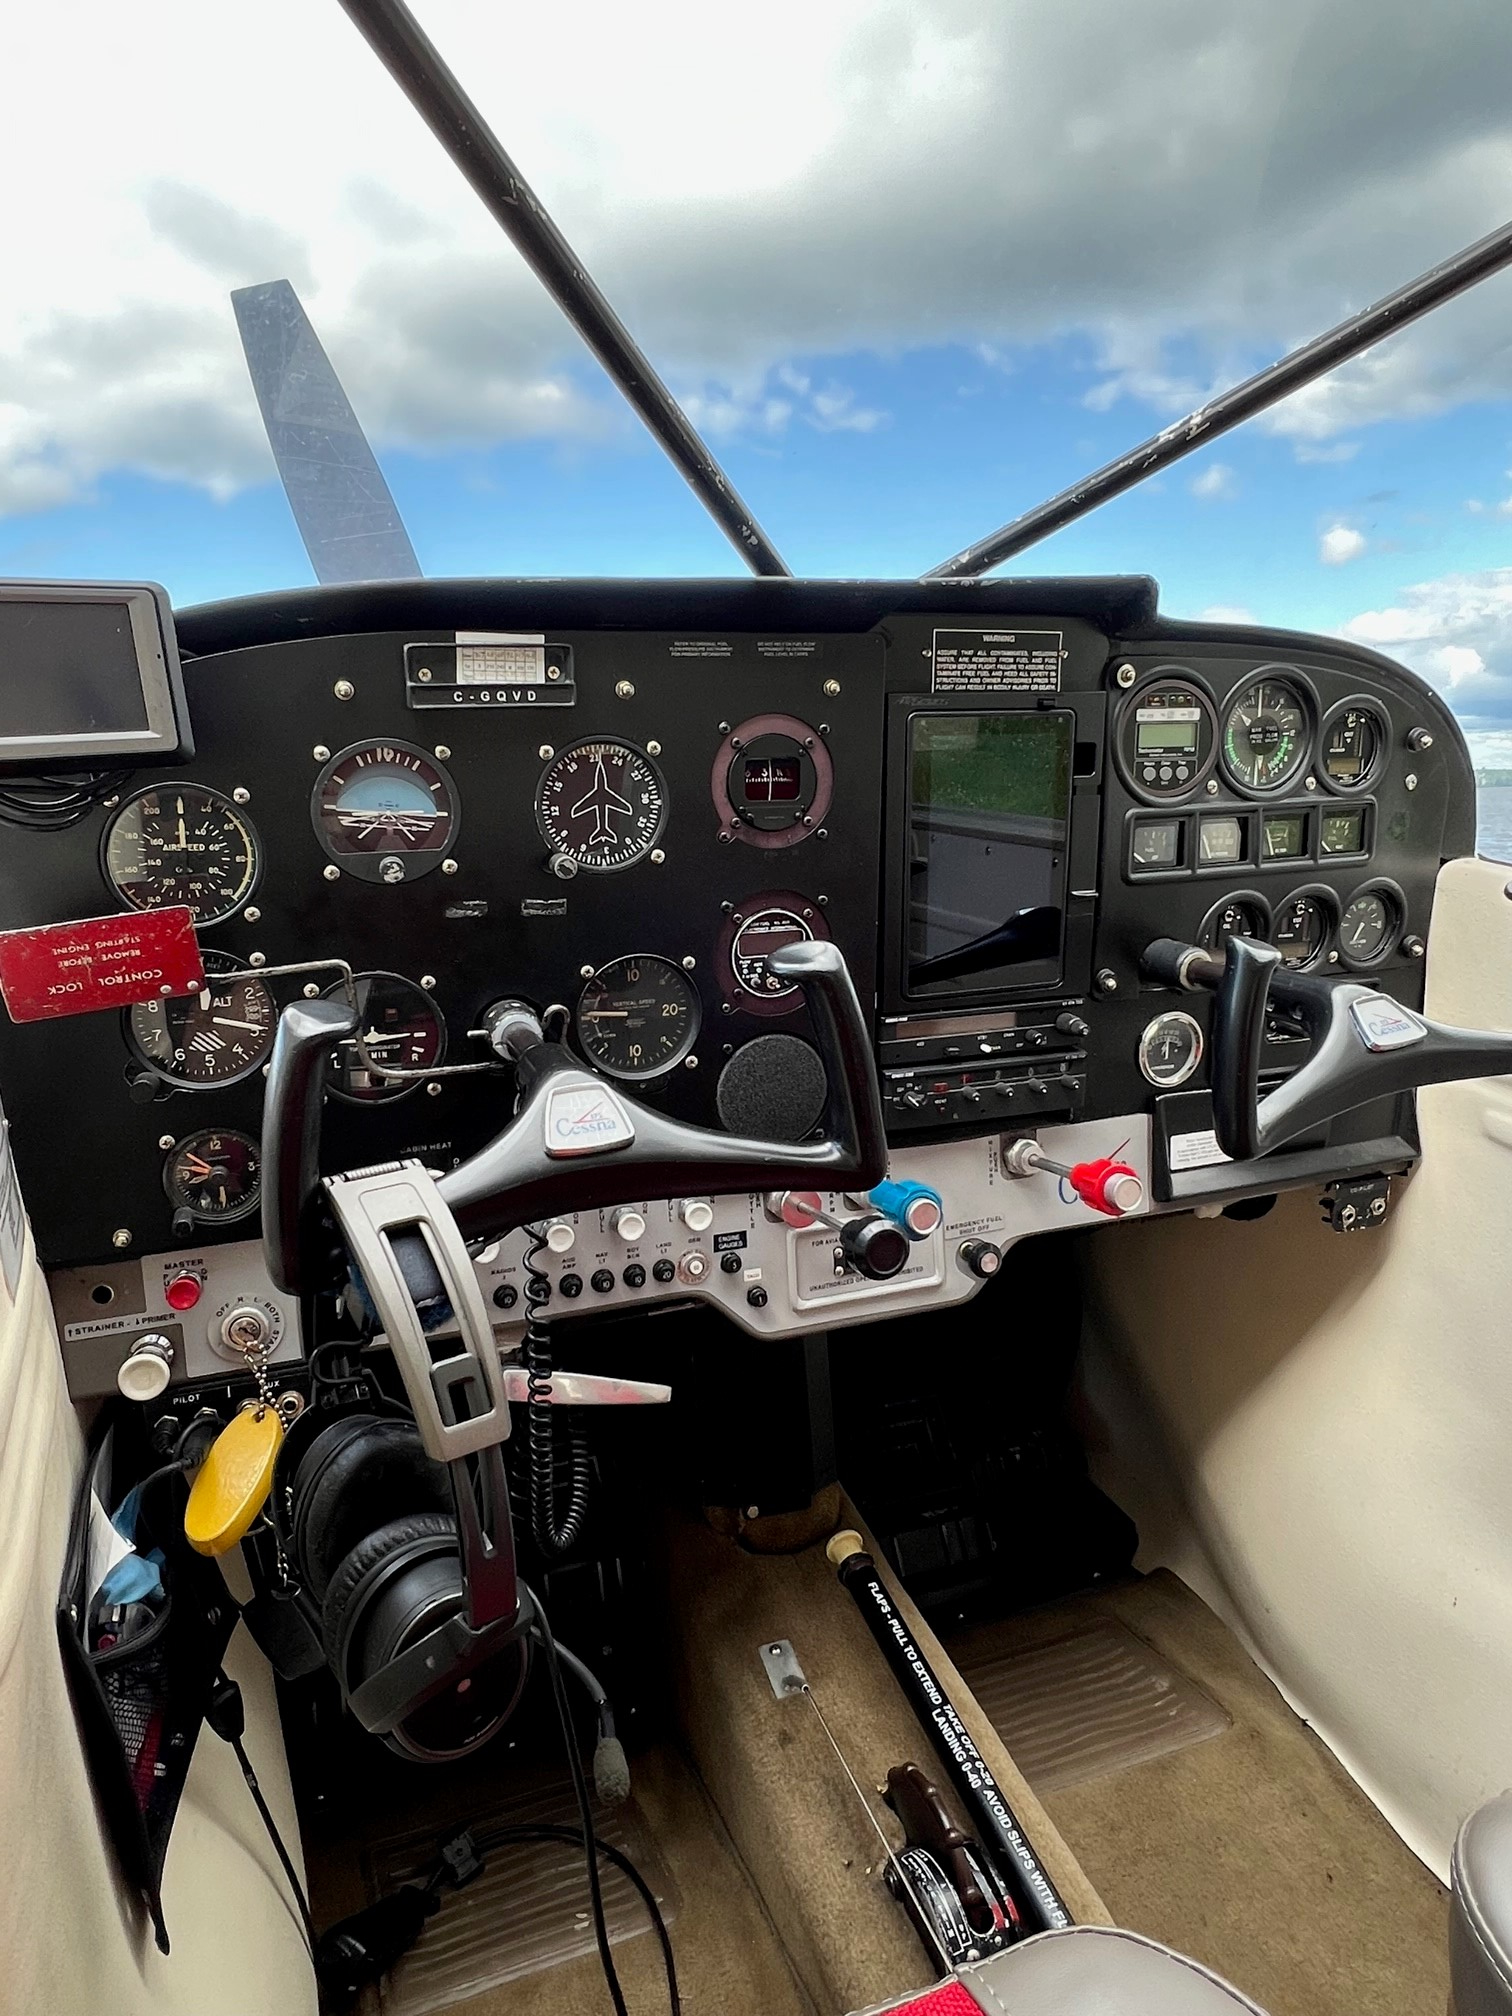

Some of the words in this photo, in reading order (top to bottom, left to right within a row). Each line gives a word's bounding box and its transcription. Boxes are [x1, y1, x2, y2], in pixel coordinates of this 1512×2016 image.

[567, 762, 578, 773] 18
[612, 756, 624, 766] 24
[630, 770, 642, 781] 27
[553, 781, 563, 792] 15
[641, 792, 649, 804] 30
[95, 936, 141, 949] STARTING
[52, 944, 91, 956] ENGINE
[102, 950, 141, 962] REMOVE
[58, 955, 93, 968] BEFORE
[98, 969, 163, 987] CONTROL
[627, 968, 640, 982] 10
[48, 983, 83, 996] LOCK
[245, 987, 255, 1000] 2
[148, 1000, 158, 1012] 8
[213, 996, 232, 1008] ALT
[662, 1004, 679, 1017] 20
[152, 1029, 162, 1042] 7
[1369, 1022, 1410, 1036] Cessna
[175, 1049, 186, 1061] 6
[232, 1043, 244, 1054] 4
[629, 1044, 642, 1057] 10
[205, 1054, 216, 1067] 5
[556, 1118, 616, 1136] Cessna
[210, 1140, 221, 1150] 12
[430, 1142, 452, 1150] HEAT
[248, 1161, 255, 1171] 3
[183, 1171, 190, 1180] 9
[946, 1218, 984, 1231] EMERGENCY
[164, 1259, 203, 1270] MASTER
[899, 1266, 924, 1275] HIBITED
[571, 1286, 577, 1294] 2
[809, 1278, 854, 1292] UNAUTHORIZED
[216, 1303, 230, 1317] OFF
[264, 1302, 280, 1323] BOTH
[75, 1321, 124, 1335] STRAINER
[142, 1313, 176, 1324] PRIMER
[173, 1394, 200, 1405] PILOT
[868, 1582, 891, 1613] FLAPS
[888, 1619, 908, 1647] PULL
[904, 1645, 918, 1661] TO
[912, 1661, 942, 1705] EXTEND
[932, 1708, 967, 1762] LANDING
[962, 1762, 982, 1788] 0-40
[943, 1704, 966, 1734] TAKE
[961, 1735, 980, 1759] OFF
[975, 1761, 995, 1786] 0-20
[983, 1790, 1012, 1829] AVOID
[1008, 1830, 1036, 1870] SLIPS
[1031, 1870, 1059, 1910] WITH
